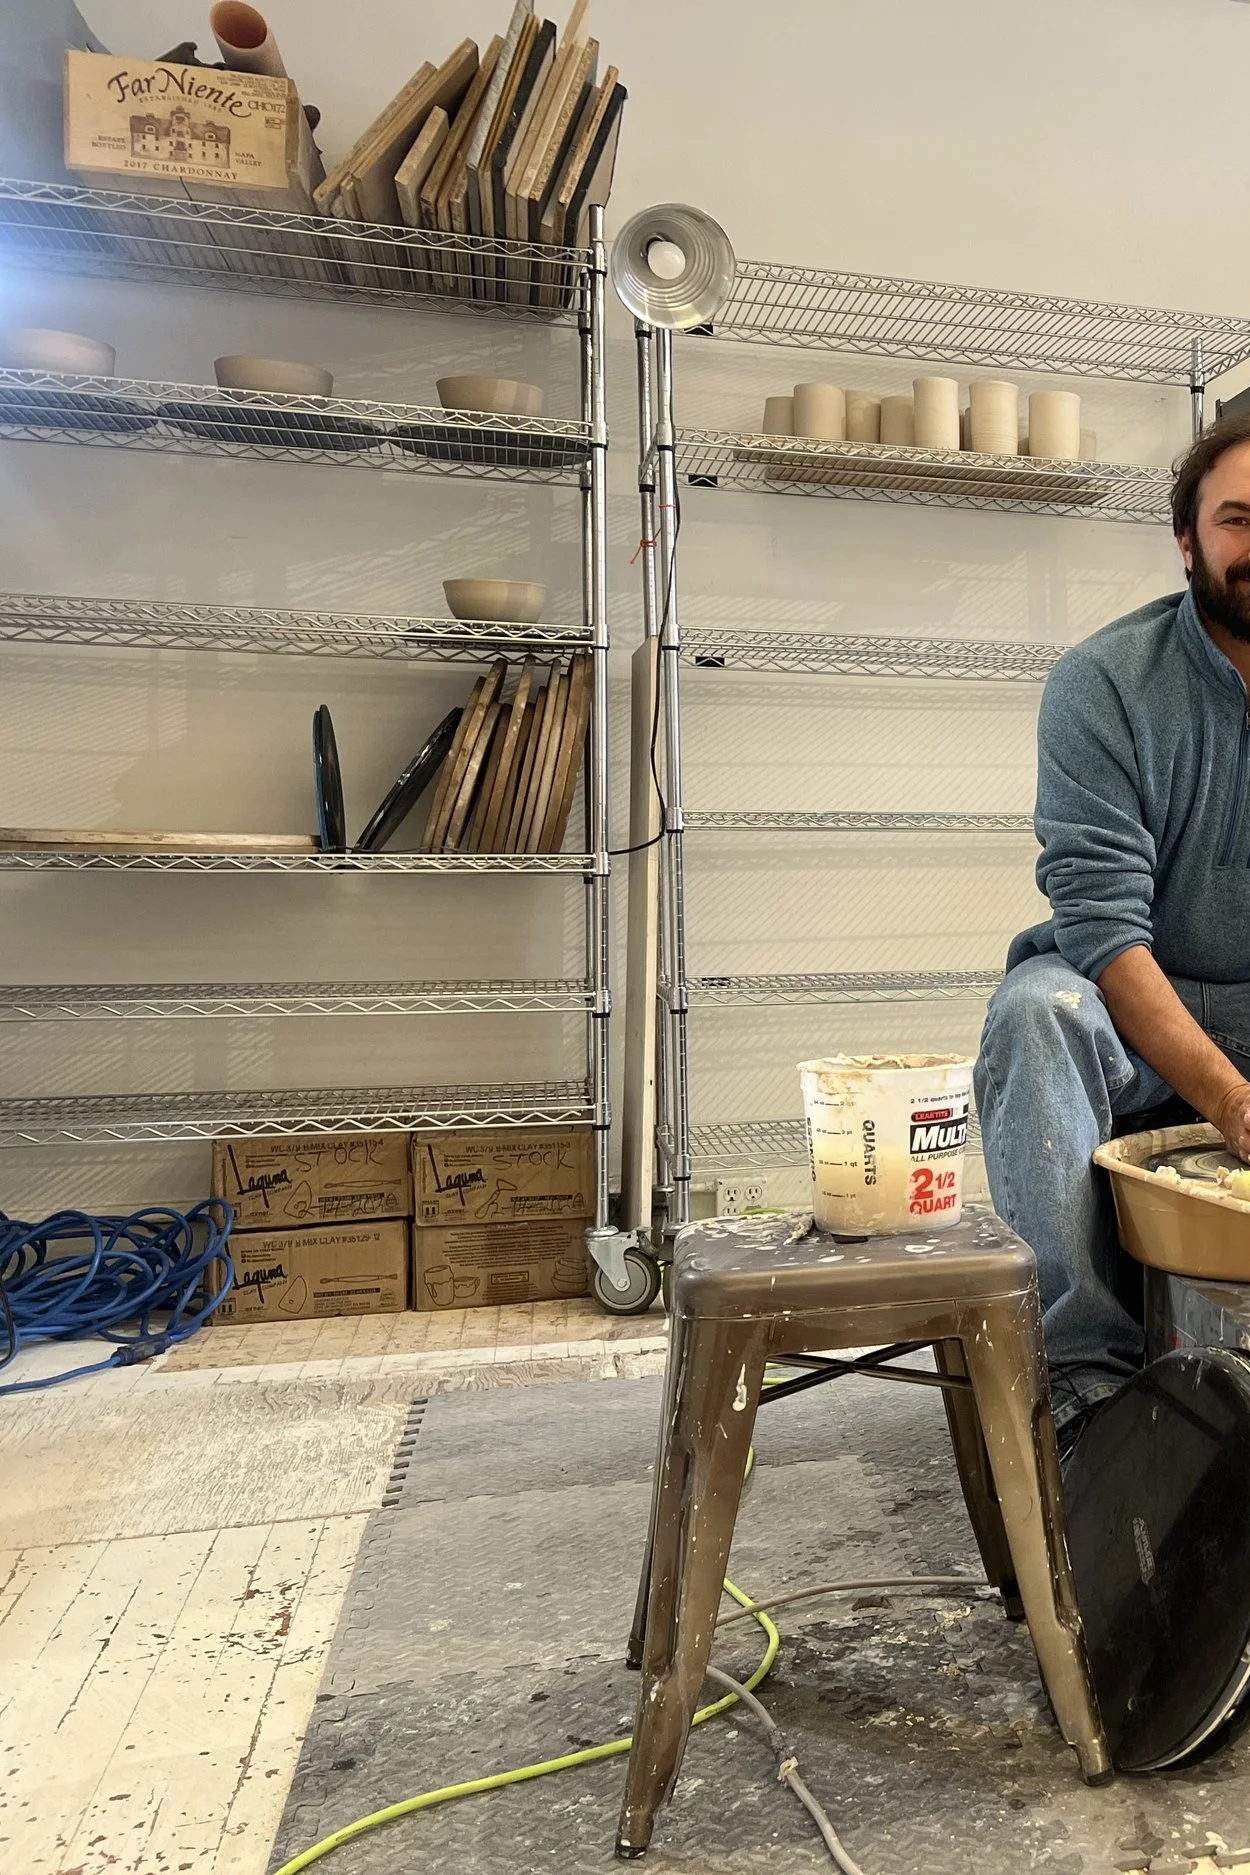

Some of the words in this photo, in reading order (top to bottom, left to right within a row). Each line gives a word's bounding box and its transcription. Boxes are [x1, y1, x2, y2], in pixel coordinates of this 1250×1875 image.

[107, 71, 156, 103] Far
[155, 68, 252, 118] Niente
[124, 160, 148, 169] 2017
[153, 162, 238, 180] CHARDONNAY
[295, 1142, 383, 1172] STOCK
[327, 1140, 348, 1149] CLAY
[517, 1143, 537, 1151] CLAY
[862, 1120, 877, 1186] QUARTS
[927, 1149, 958, 1160] PURPOSE
[492, 1149, 575, 1170] STOCK
[227, 1144, 292, 1208] Laguna
[427, 1144, 488, 1207] Laguna
[911, 1168, 934, 1200] 2
[935, 1171, 955, 1189] 1/2
[909, 1193, 957, 1215] QUART
[319, 1235, 341, 1245] CLAY
[226, 1241, 288, 1304] Laguna
